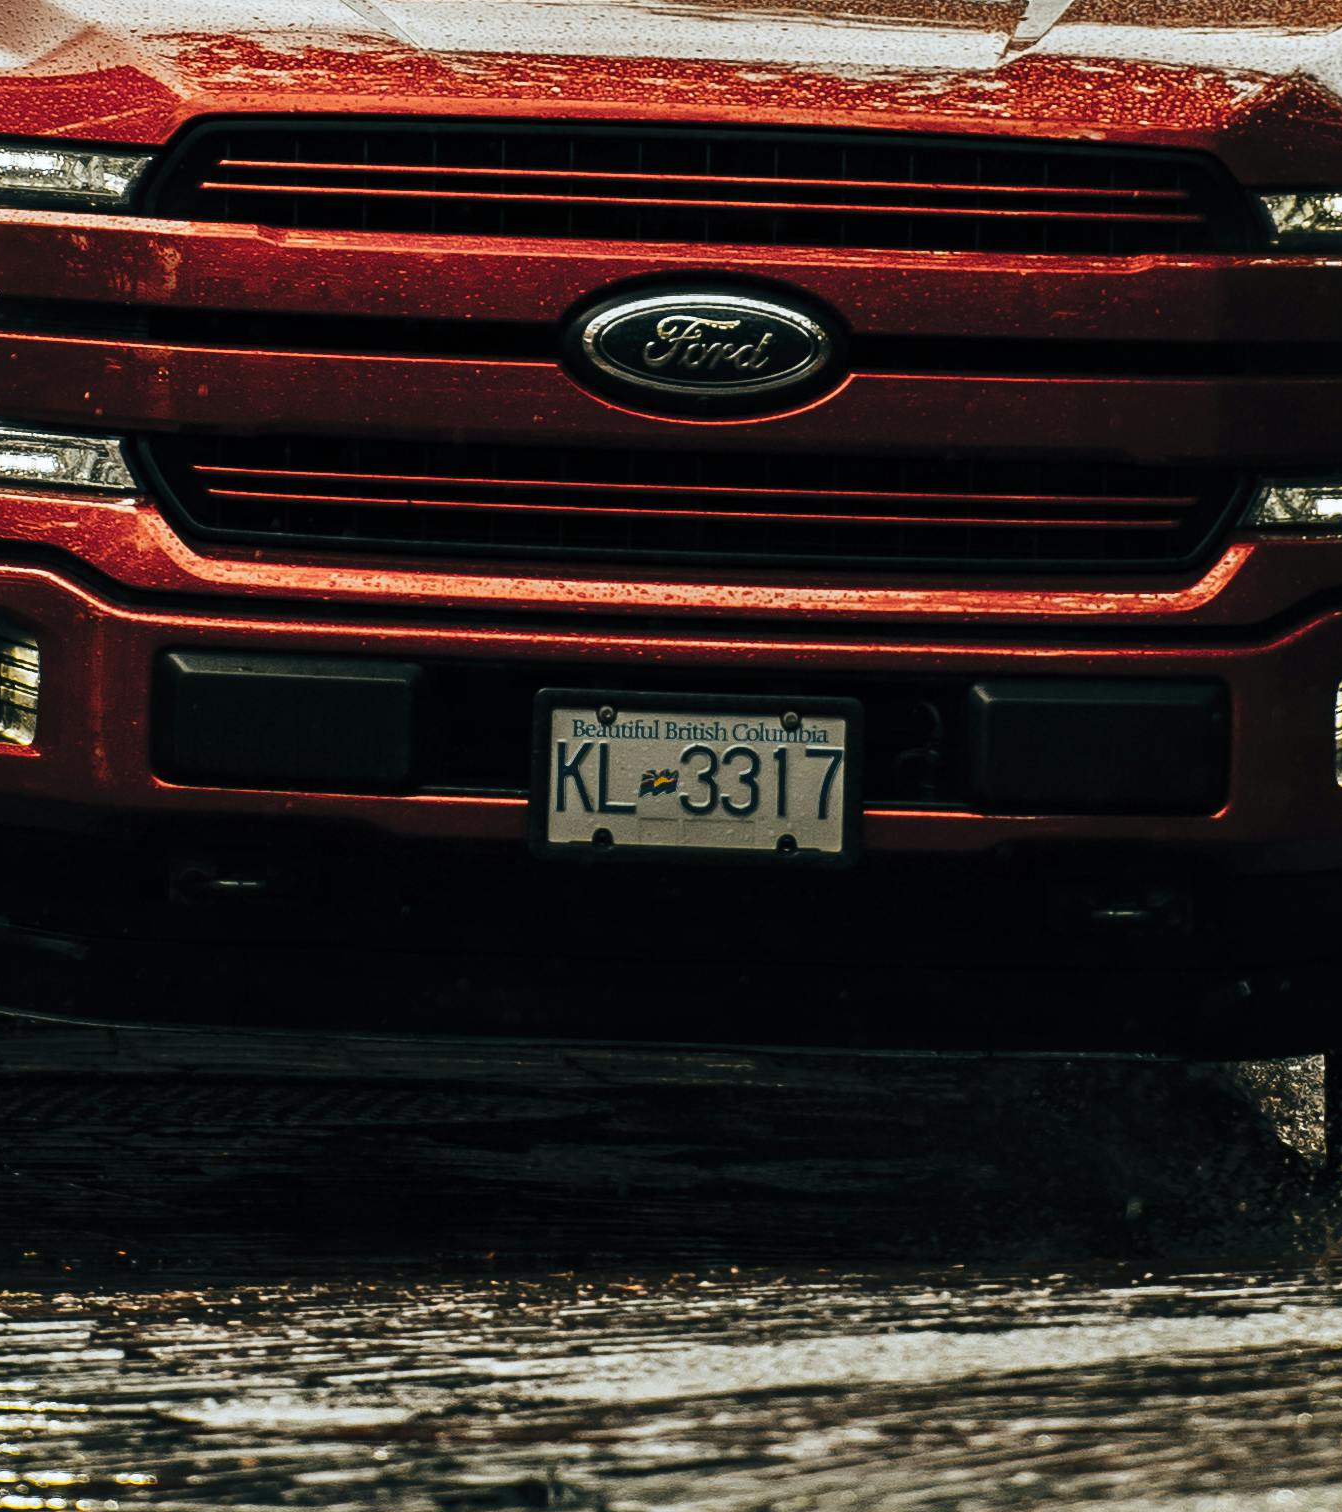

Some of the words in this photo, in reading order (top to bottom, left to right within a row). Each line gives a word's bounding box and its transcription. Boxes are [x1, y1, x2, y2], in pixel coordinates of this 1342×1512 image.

[643, 315, 772, 369] Ford
[572, 718, 660, 739] Beautiful
[664, 721, 728, 742] British
[732, 722, 829, 744] Columbia
[555, 739, 638, 814] KL
[678, 742, 846, 821] 3317
